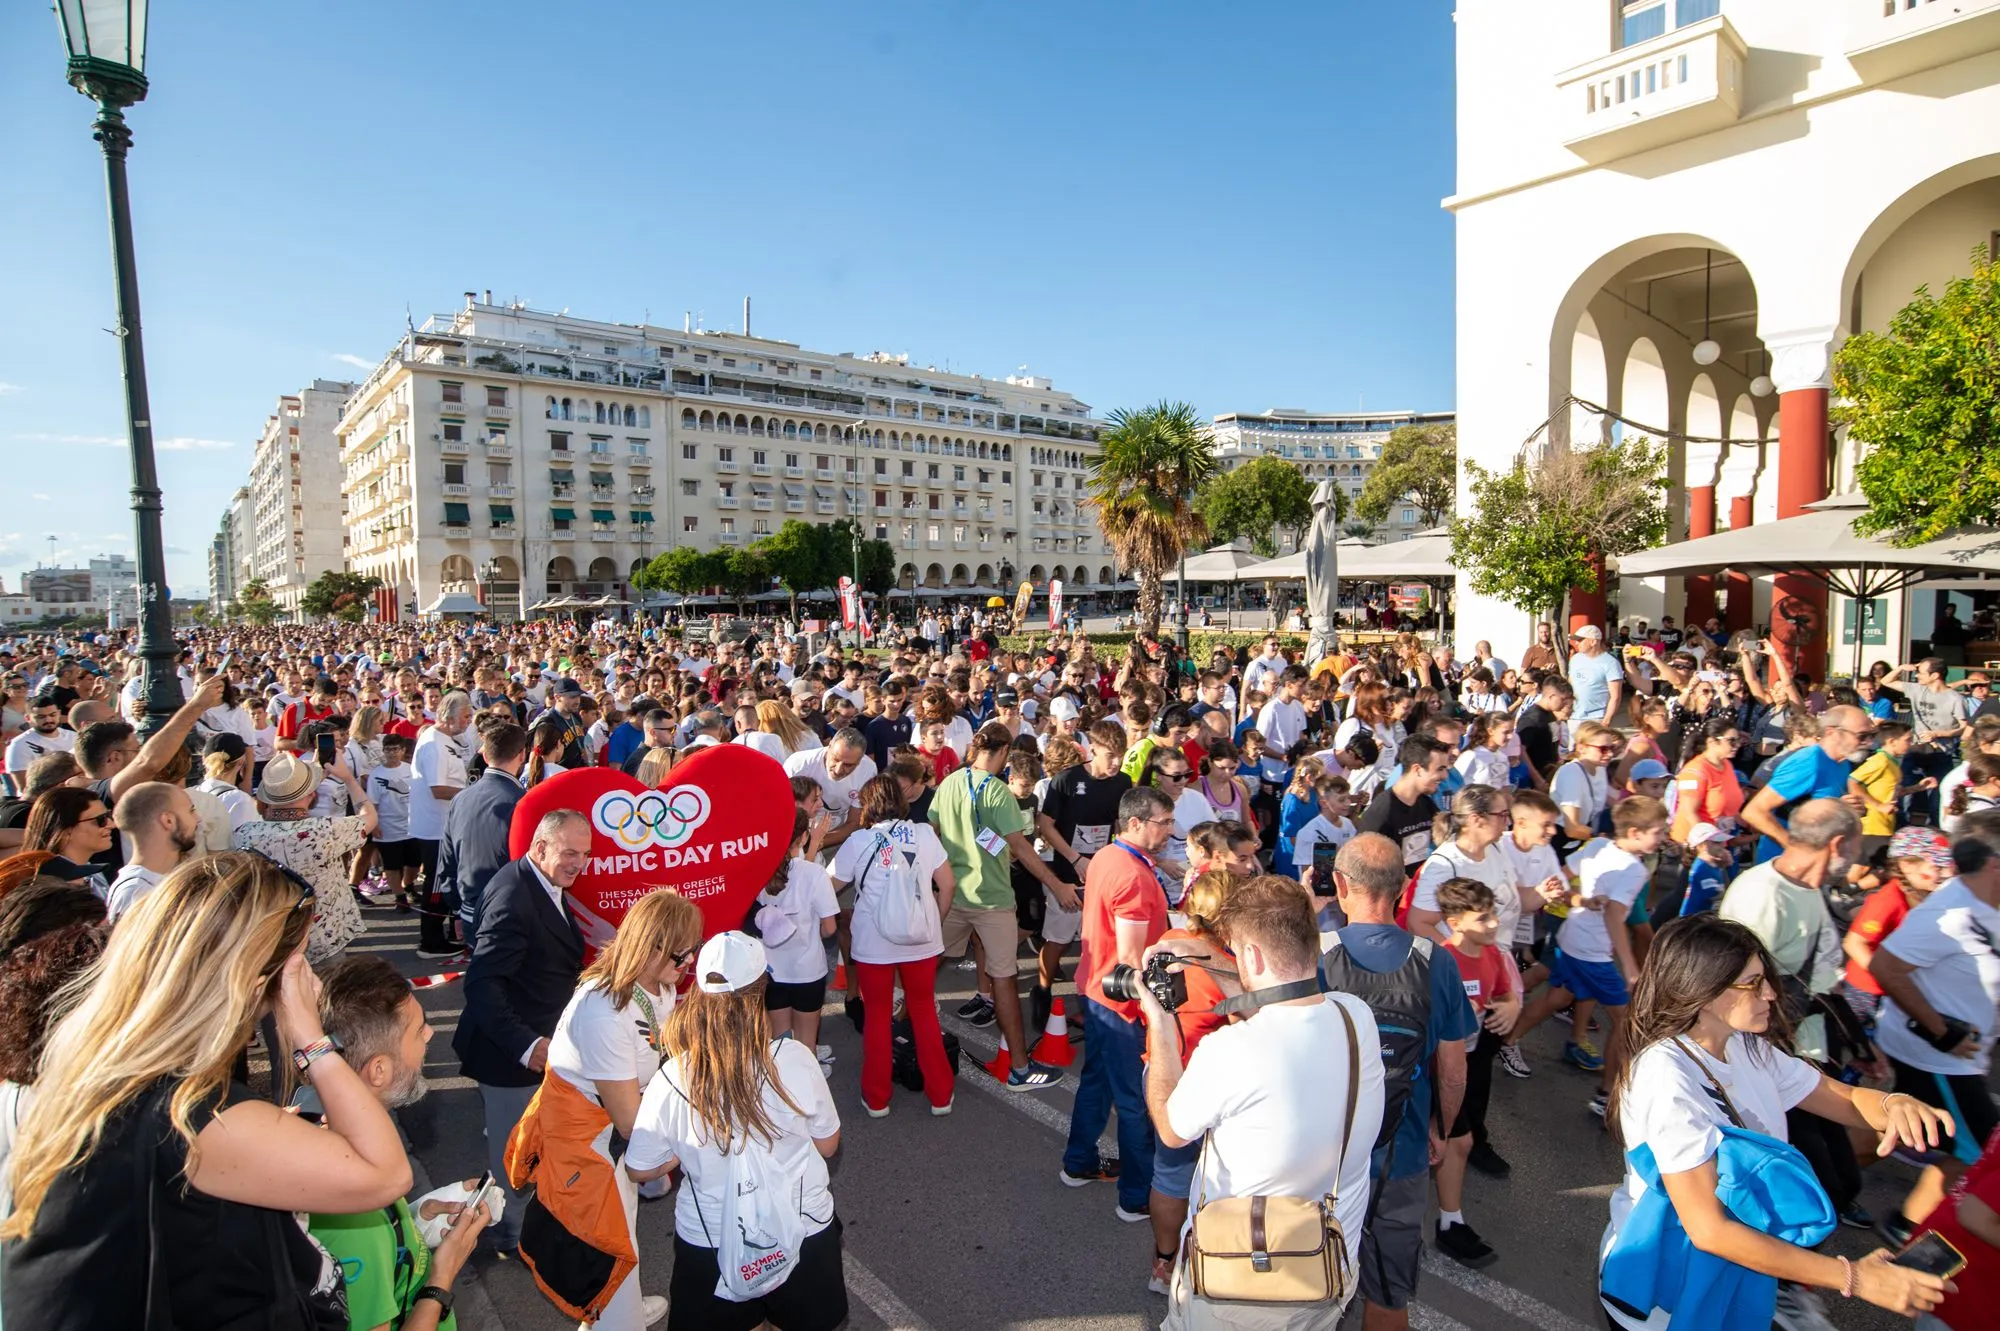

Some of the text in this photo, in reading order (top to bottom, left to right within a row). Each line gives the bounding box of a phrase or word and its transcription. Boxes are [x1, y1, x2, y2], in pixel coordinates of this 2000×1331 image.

[581, 832, 769, 876] YMPIC DAY RUN
[679, 883, 726, 899] USEUM
[682, 875, 725, 890] GREECE
[740, 1250, 785, 1273] OLYMPIC
[743, 1266, 763, 1281] DAY
[764, 1256, 787, 1272] RUN
